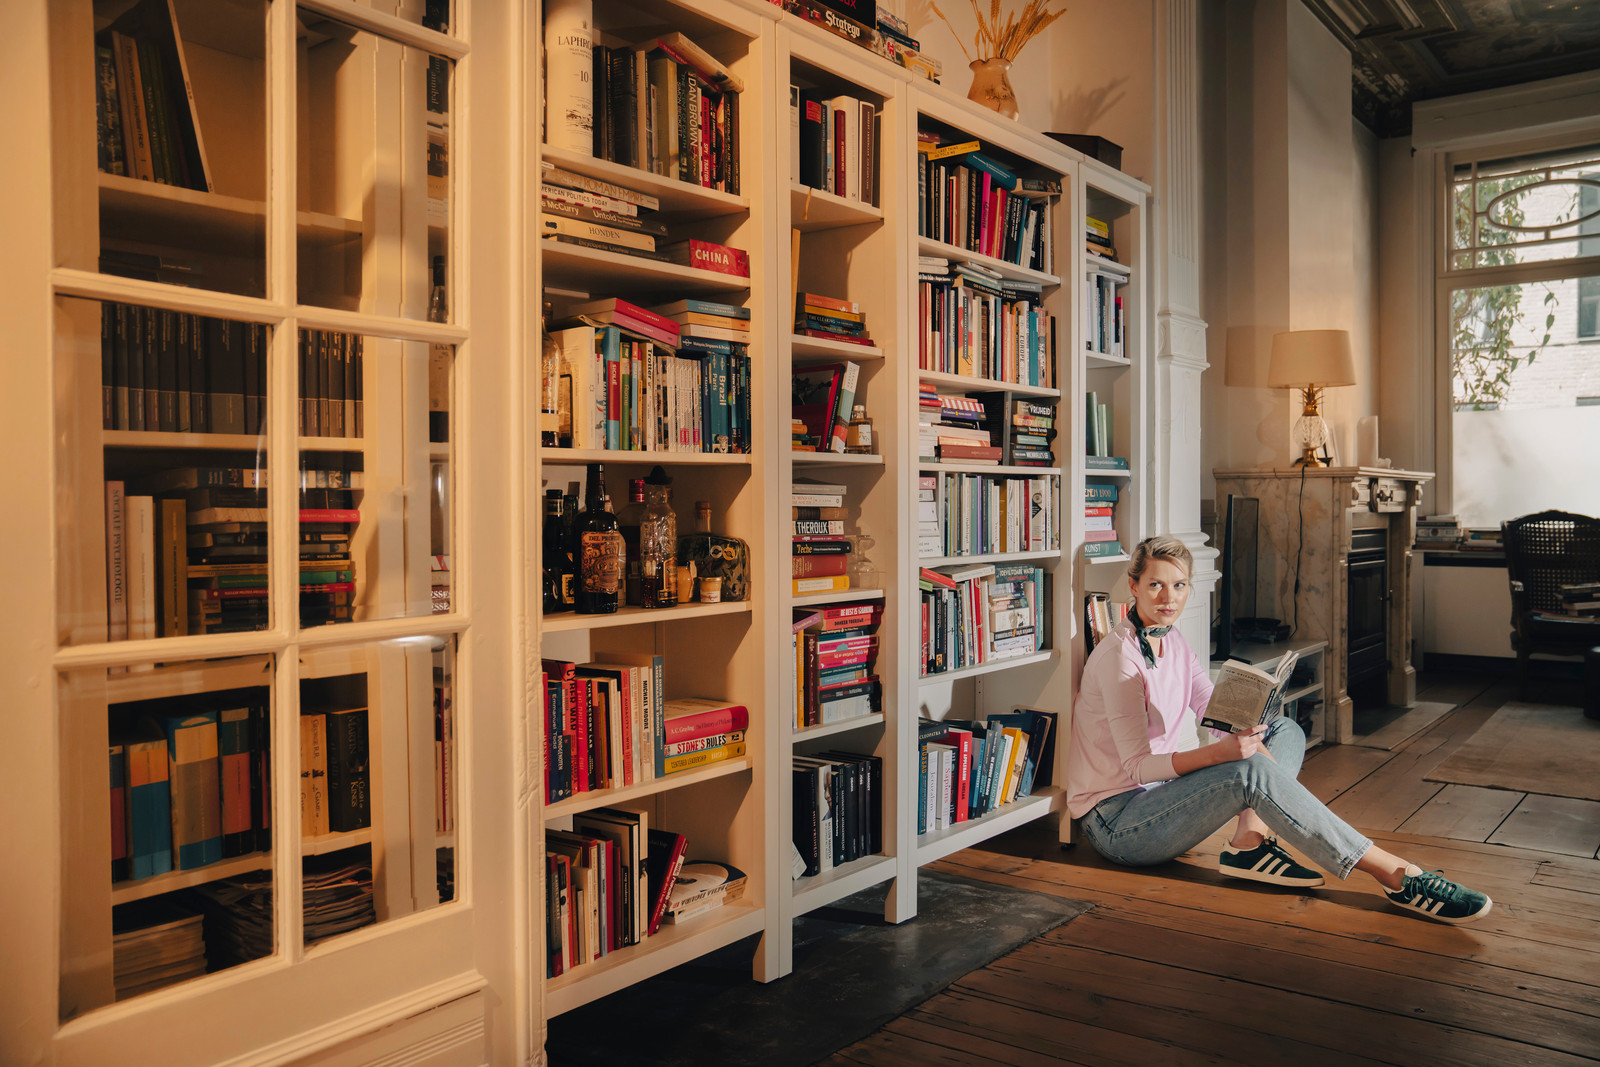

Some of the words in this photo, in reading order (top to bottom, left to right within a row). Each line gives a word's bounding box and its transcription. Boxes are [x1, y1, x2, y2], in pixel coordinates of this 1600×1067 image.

[825, 10, 860, 39] Stratego
[580, 70, 589, 83] 10
[688, 77, 697, 102] DAN
[689, 103, 698, 148] BROWN
[584, 179, 615, 198] ROMAN
[566, 192, 590, 202] POLITICS
[591, 197, 608, 206] TODAY
[547, 200, 580, 216] McCurry
[592, 210, 618, 222] Untold
[589, 226, 620, 240] HONDEN
[696, 249, 730, 266] CHINA
[718, 375, 726, 406] Brazil
[1099, 489, 1112, 498] 1900
[112, 490, 121, 532] SOCIALE
[796, 522, 828, 534] THEROUX
[114, 534, 123, 604] PSYCHOLOGIE
[679, 725, 695, 733] Grayling
[919, 731, 941, 740] CLEOPATRA
[677, 738, 706, 754] STONE'S
[706, 734, 727, 749] RULES
[670, 759, 687, 769] CENTERED
[688, 754, 707, 765] LEADERSHIP
[943, 767, 951, 804] Sapiens
[350, 781, 358, 808] KINGS
